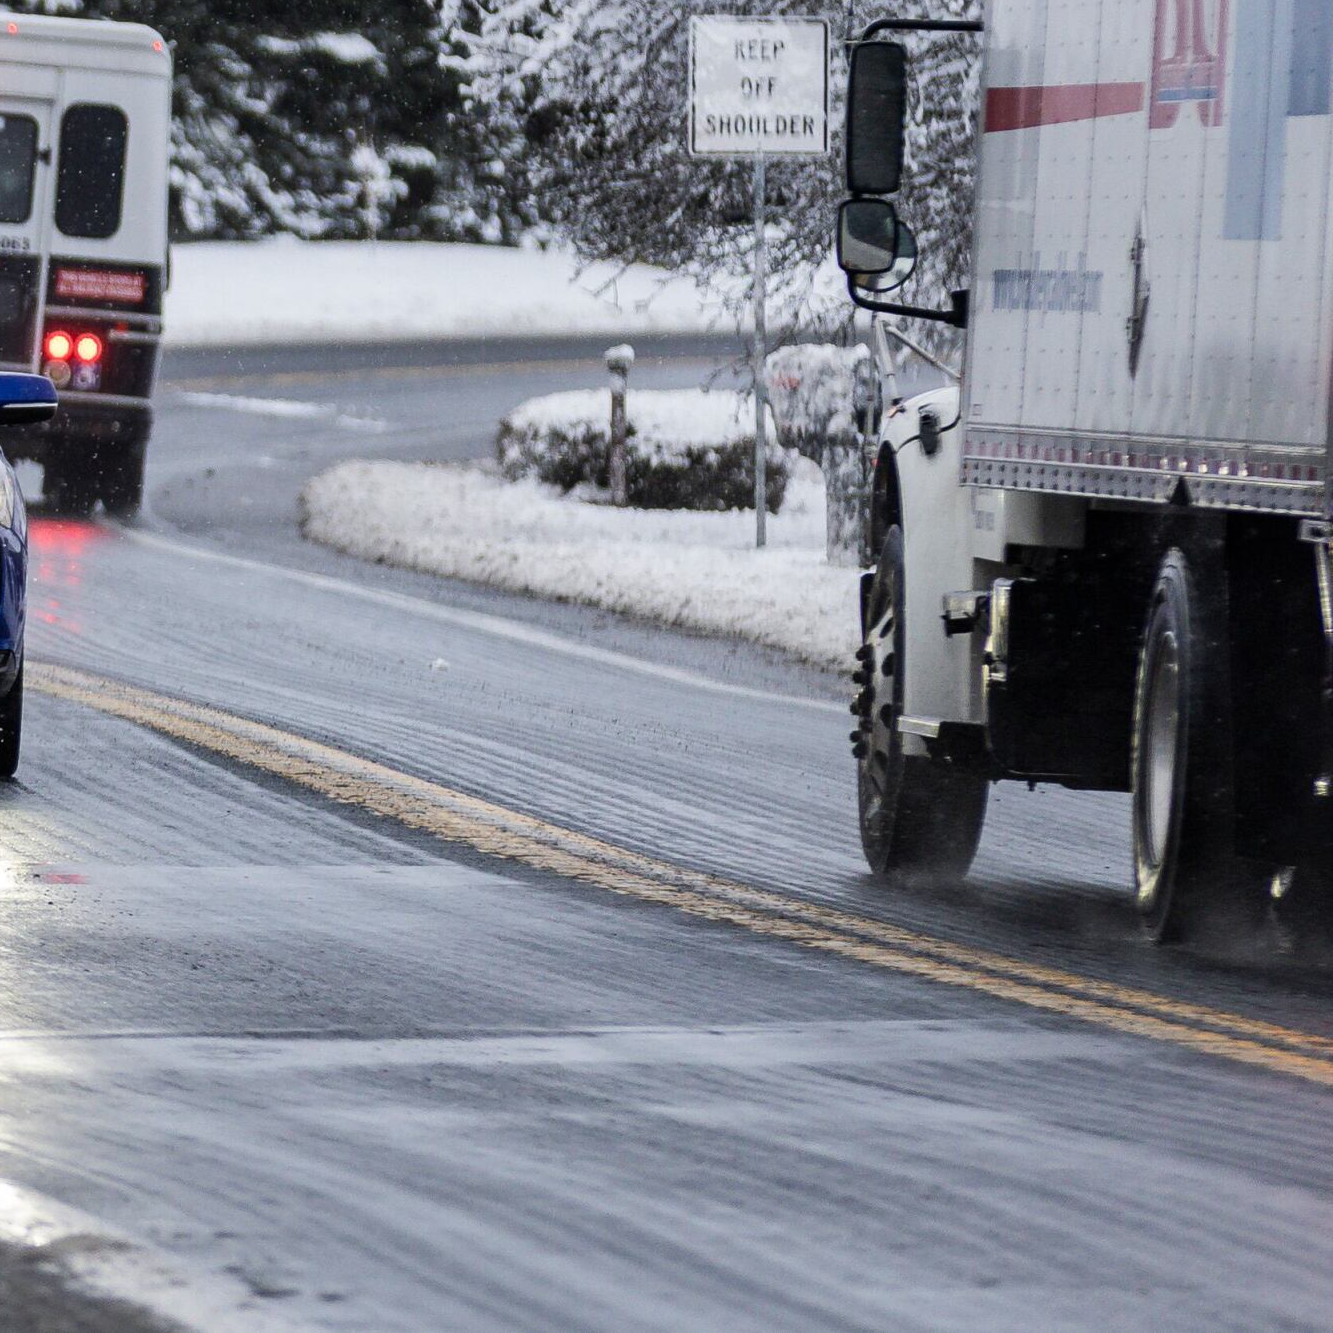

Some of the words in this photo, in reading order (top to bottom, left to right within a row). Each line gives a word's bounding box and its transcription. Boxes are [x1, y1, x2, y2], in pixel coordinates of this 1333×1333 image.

[734, 38, 784, 62] KEEP
[740, 76, 776, 99] OFF
[705, 114, 815, 137] SHOULDER
